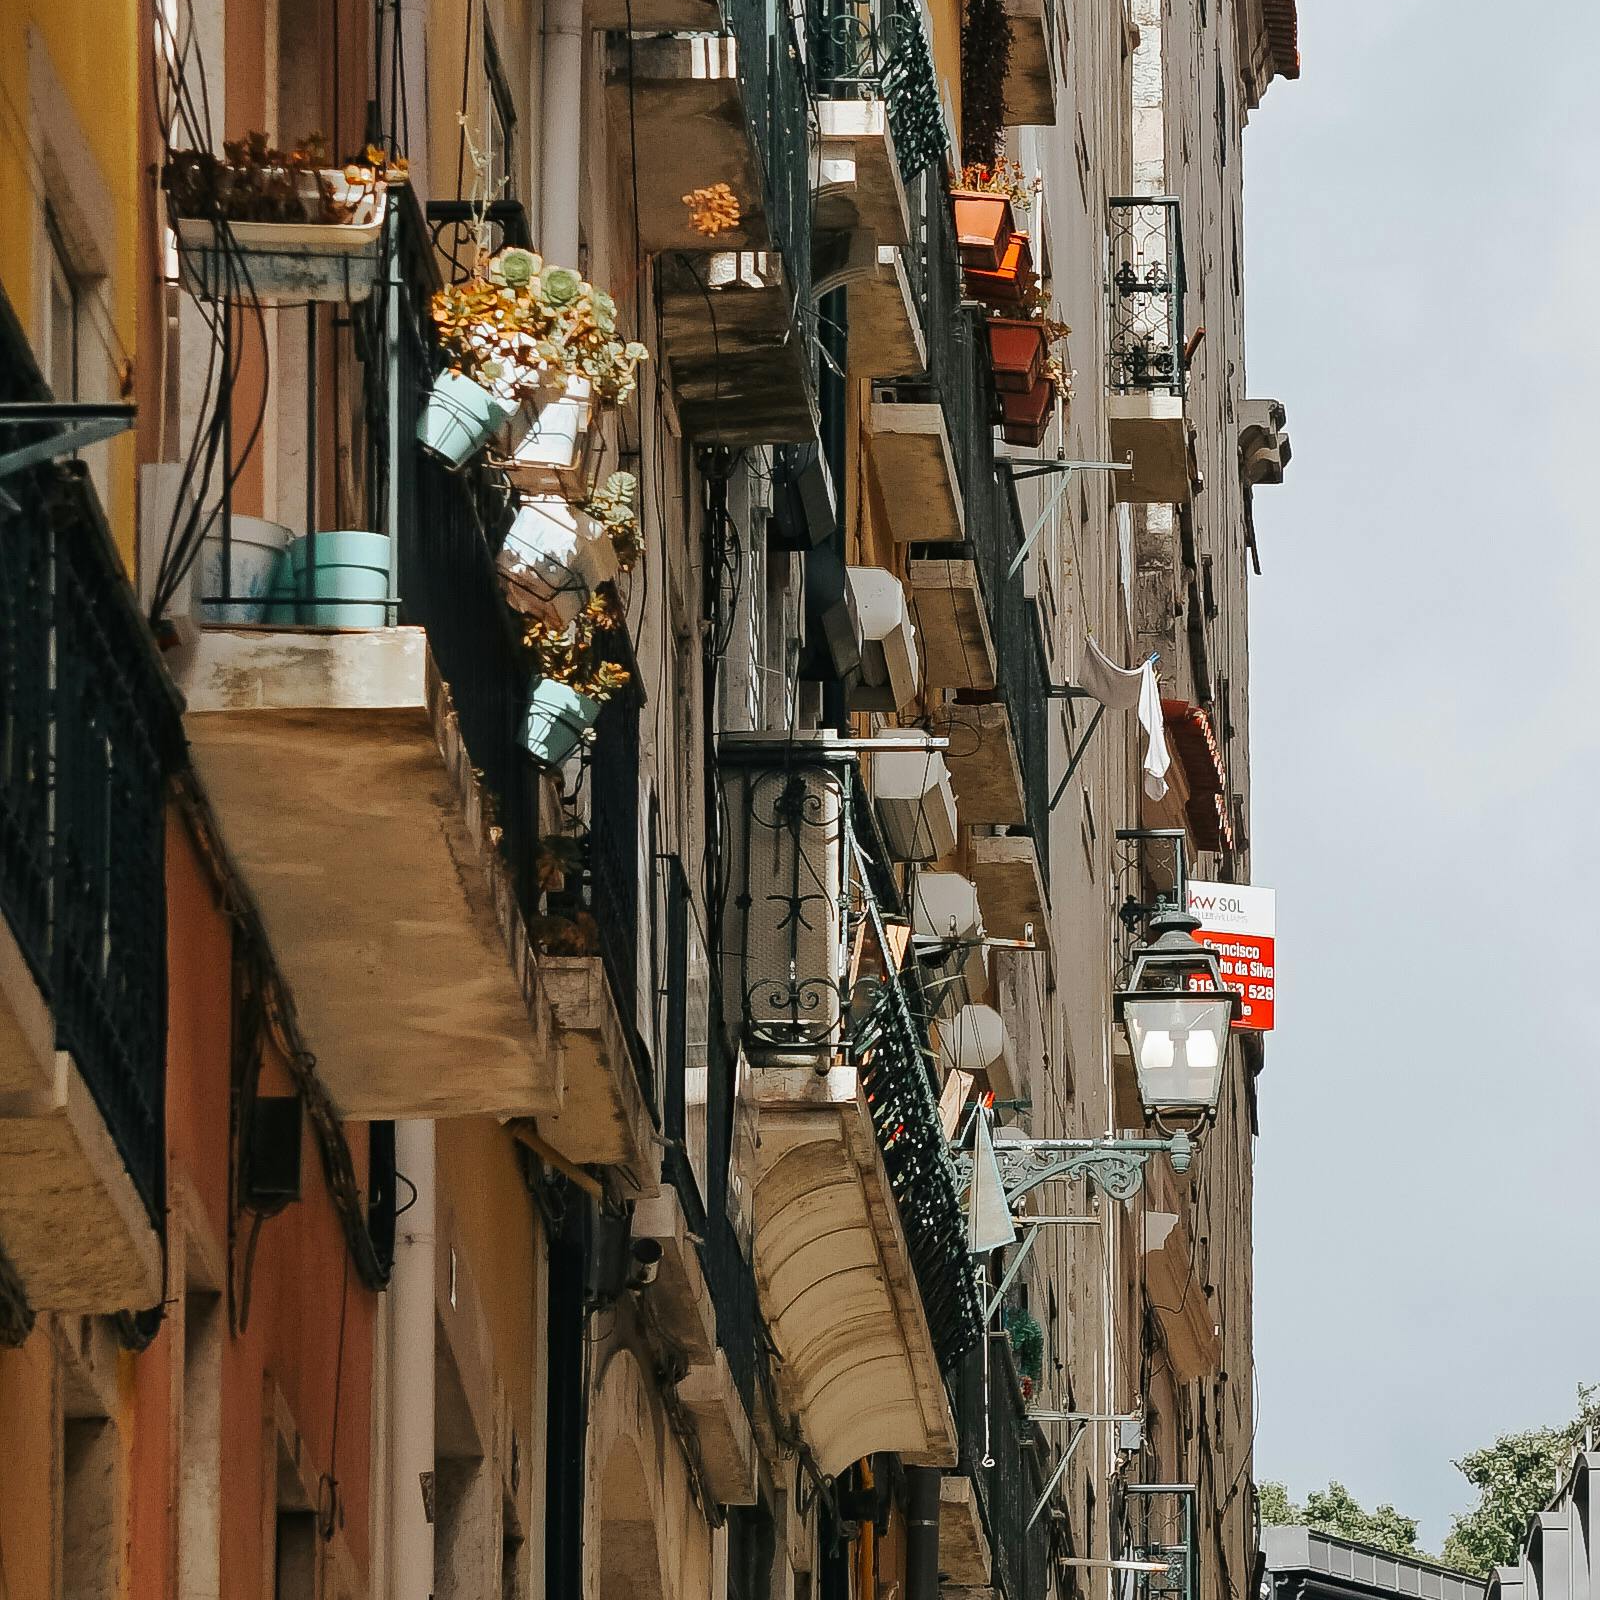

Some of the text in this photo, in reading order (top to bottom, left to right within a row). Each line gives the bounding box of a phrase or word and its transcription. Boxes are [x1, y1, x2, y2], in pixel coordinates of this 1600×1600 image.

[1219, 897, 1244, 913] SOL
[1203, 938, 1260, 960] Francisco
[1234, 960, 1248, 976] da
[1249, 961, 1274, 979] Silva
[1248, 984, 1274, 1000] 528
